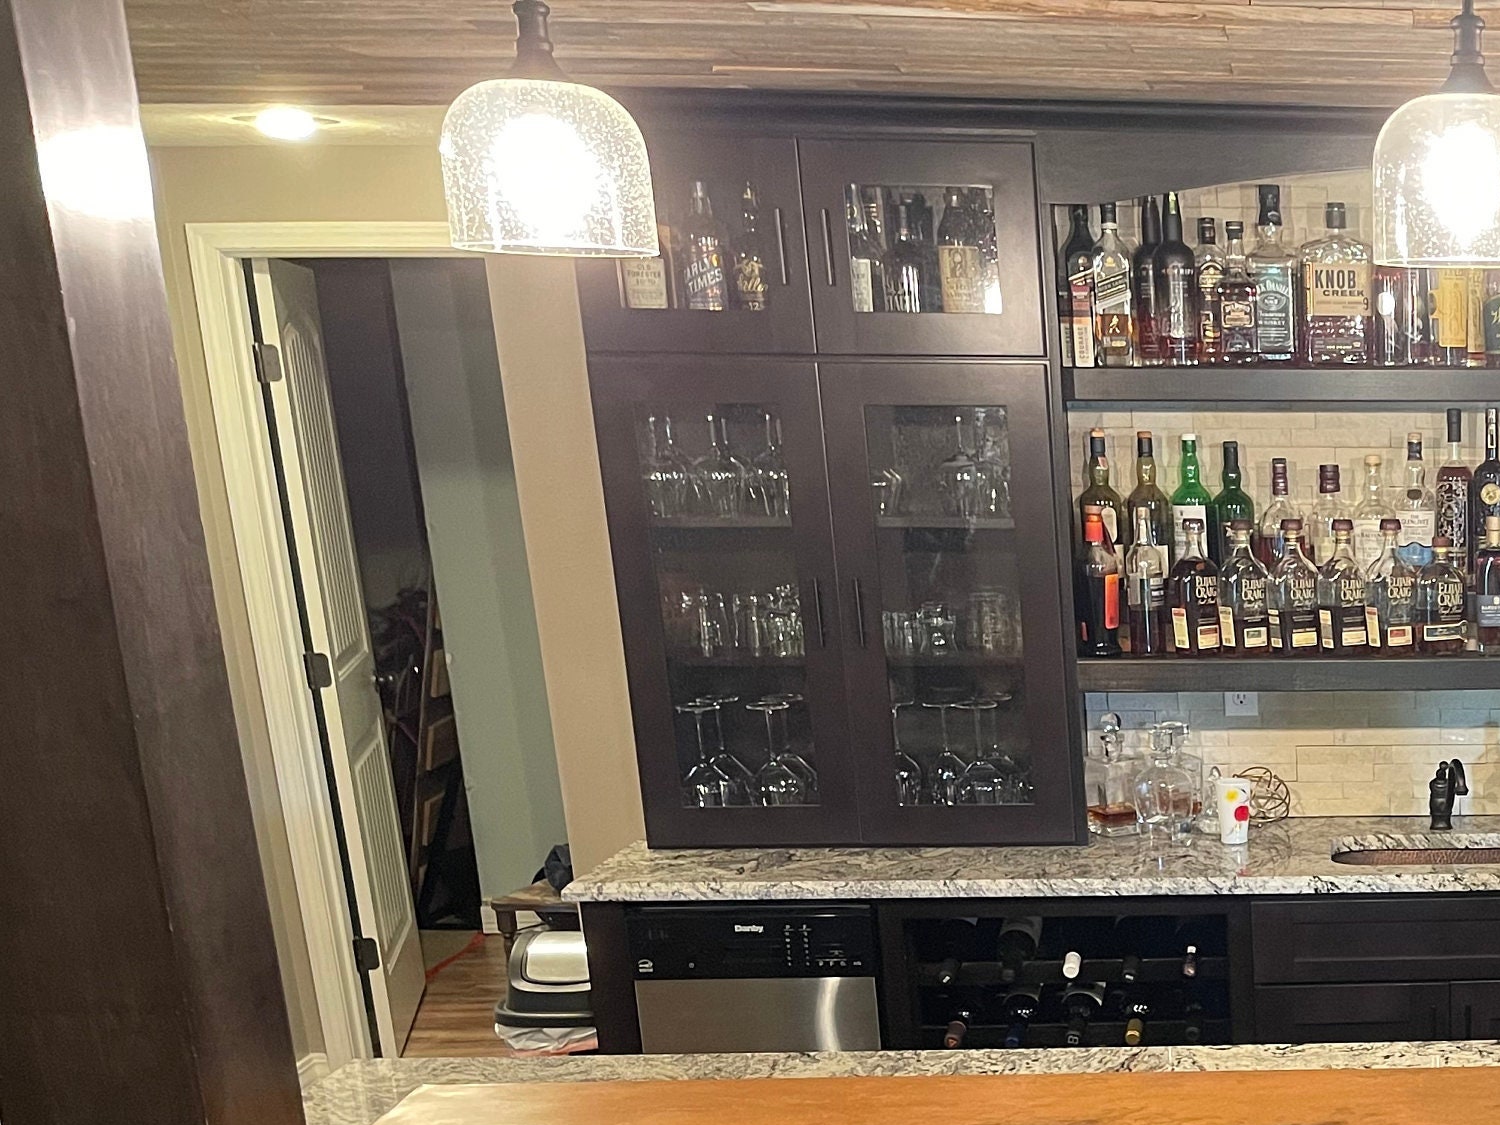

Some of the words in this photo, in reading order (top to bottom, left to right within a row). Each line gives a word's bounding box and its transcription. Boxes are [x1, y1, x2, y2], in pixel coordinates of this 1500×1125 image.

[688, 268, 723, 295] TIMES
[1314, 269, 1356, 289] KNOB
[1322, 289, 1365, 297] CREEK
[748, 301, 761, 311] 12
[1362, 297, 1369, 311] 9
[1195, 586, 1217, 598] CRAIG
[1241, 589, 1265, 601] CRAIG
[1290, 588, 1315, 600] CRAIG
[1341, 589, 1365, 601] CRAIG
[1387, 587, 1412, 599] CRAIG
[1438, 593, 1463, 607] CRAIG
[734, 924, 764, 933] Danby
